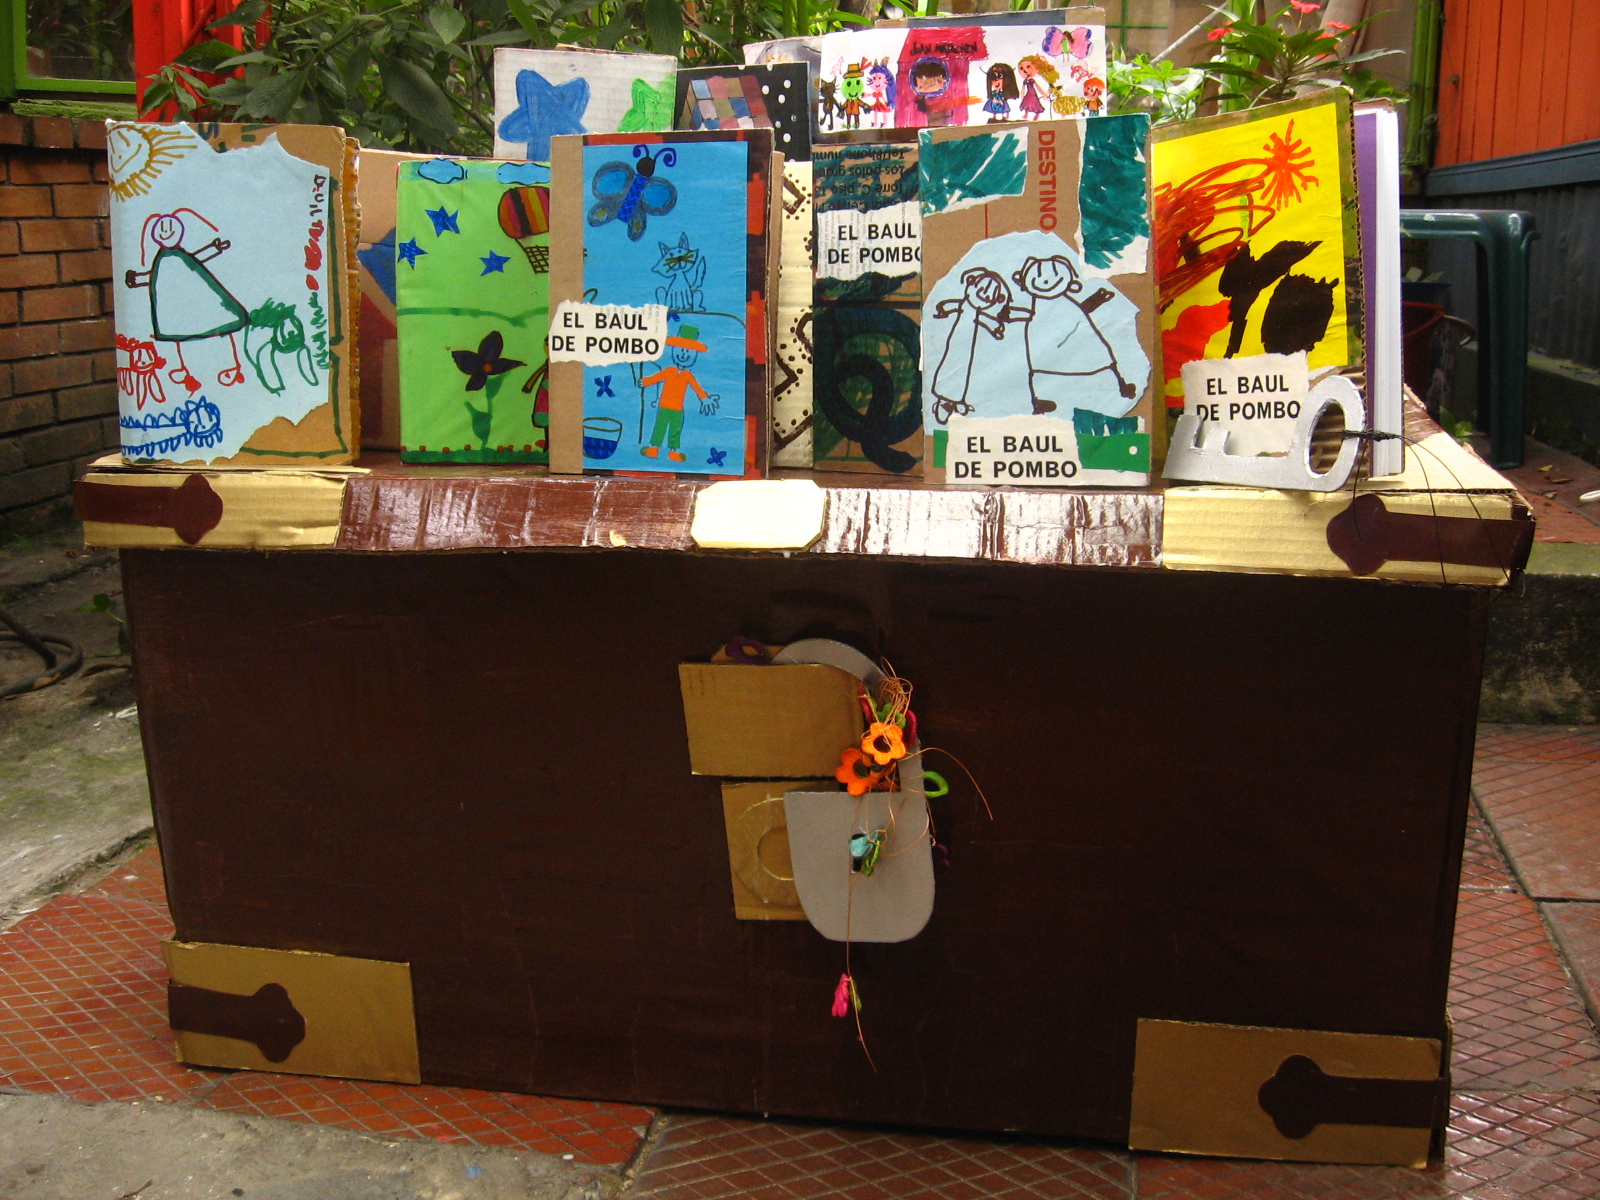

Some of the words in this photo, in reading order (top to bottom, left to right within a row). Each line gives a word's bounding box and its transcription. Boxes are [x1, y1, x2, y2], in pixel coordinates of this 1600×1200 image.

[1038, 130, 1057, 231] DESTINO
[838, 225, 858, 241] EL
[868, 223, 917, 239] BAUL
[828, 248, 850, 264] DE
[563, 312, 584, 328] EL
[595, 313, 648, 330] BAUL
[552, 335, 575, 352] DE
[586, 336, 659, 355] POMBO
[1206, 378, 1227, 395] EL
[1238, 375, 1289, 394] BAUL
[1196, 404, 1220, 421] DE
[1229, 400, 1300, 420] POMBO
[967, 436, 991, 453] EL
[1003, 436, 1063, 453] BAUL
[954, 461, 982, 478] DE
[993, 461, 1077, 478] POMBO
